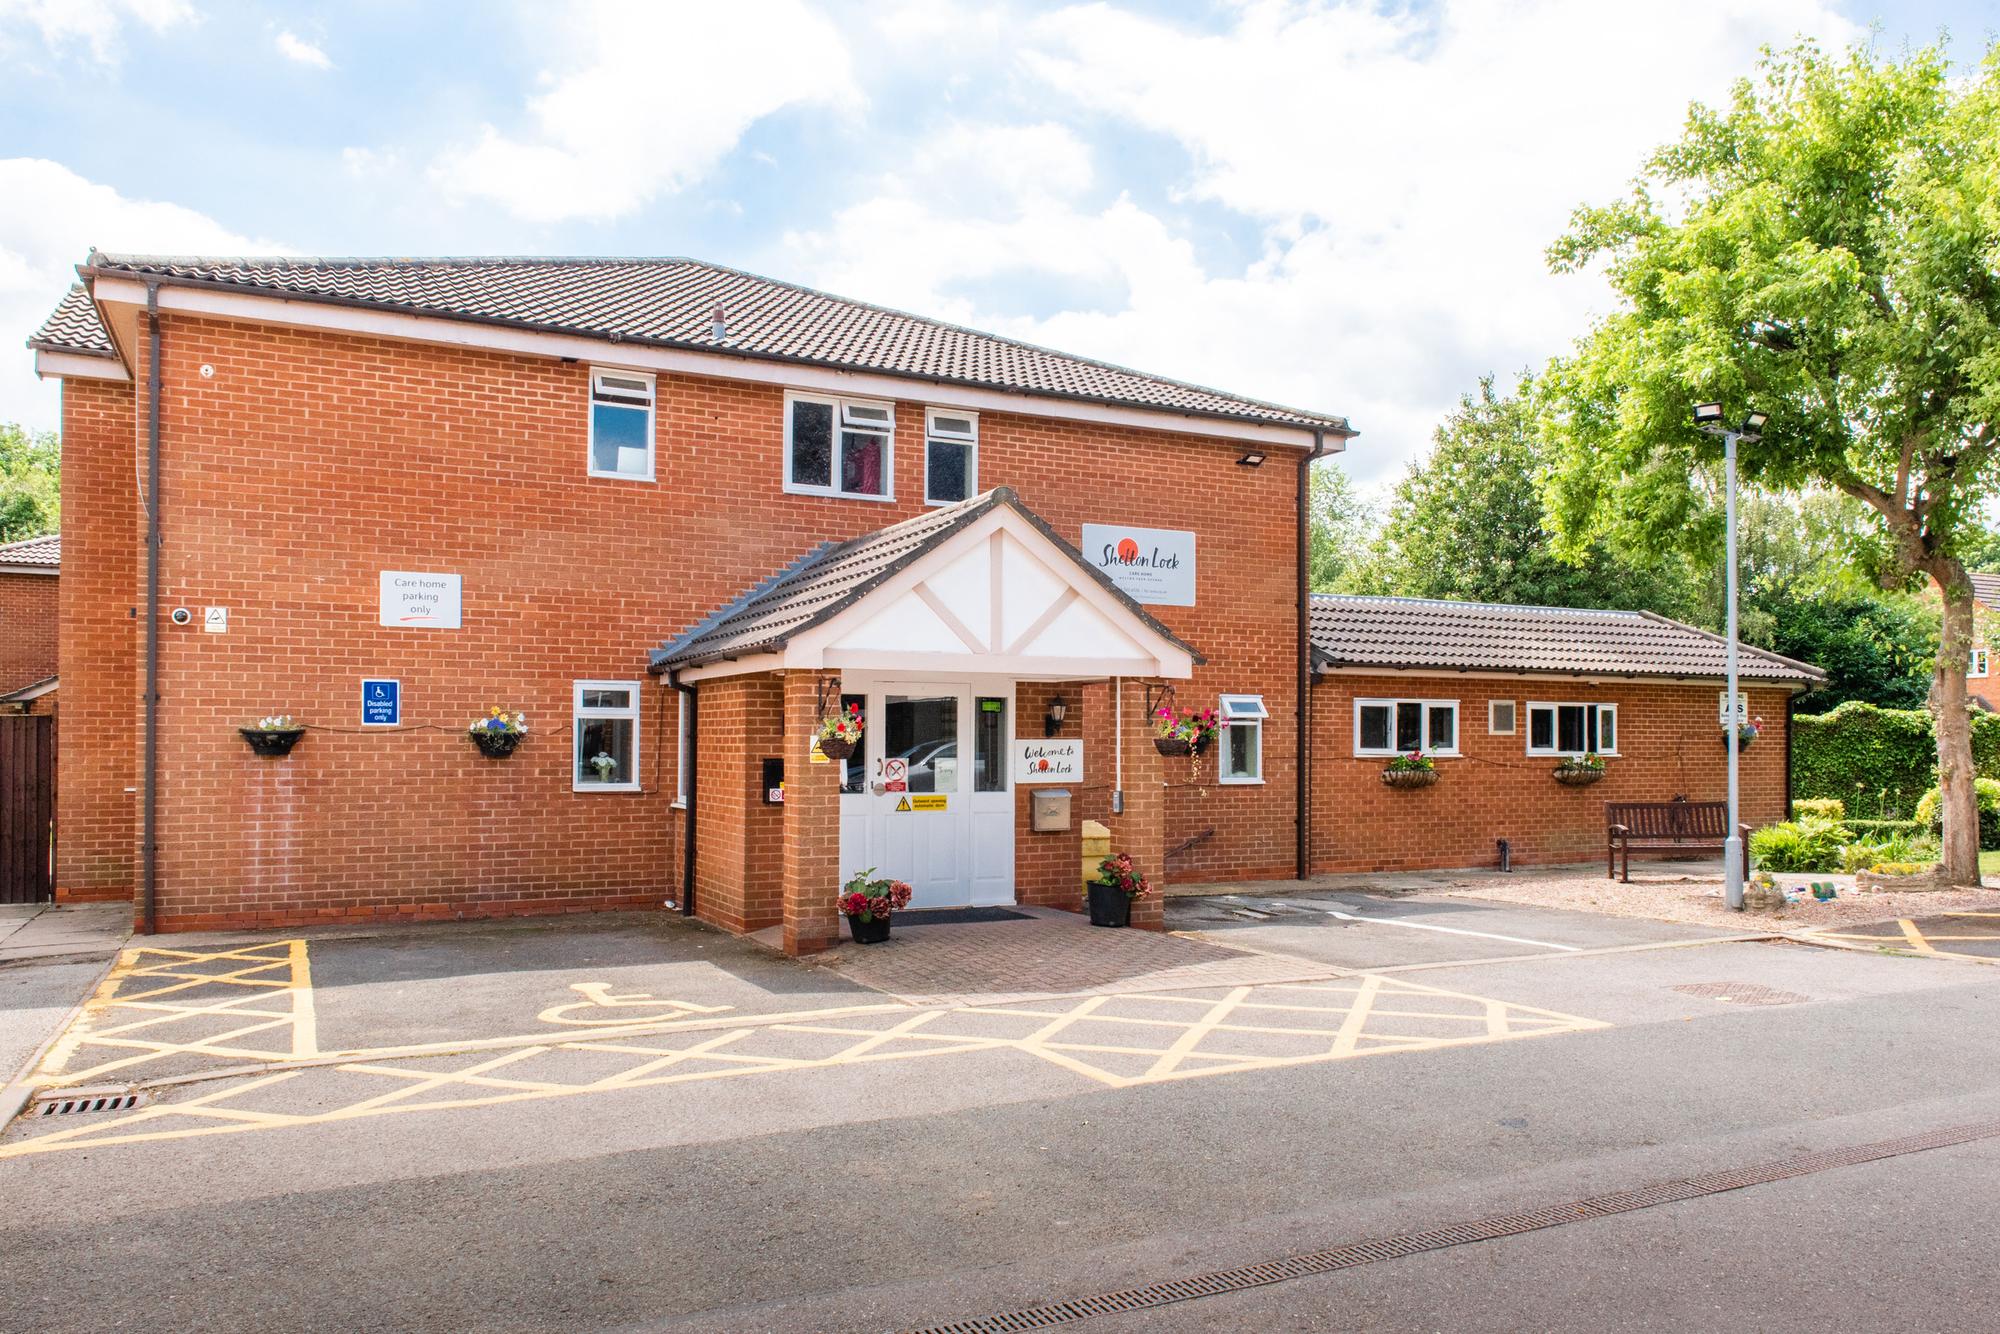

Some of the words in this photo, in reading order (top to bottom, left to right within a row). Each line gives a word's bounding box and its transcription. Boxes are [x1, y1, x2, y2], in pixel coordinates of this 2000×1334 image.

[1099, 543, 1149, 567] Shelton
[1151, 546, 1180, 569] Lock
[394, 578, 417, 587] Care
[419, 579, 447, 589] home
[402, 592, 439, 604] parking
[410, 605, 431, 615] only
[369, 707, 392, 715] parking
[1024, 746, 1066, 759] Welcome
[1066, 745, 1074, 756] to
[1026, 761, 1055, 775] Shelton
[1056, 761, 1072, 774] Lock
